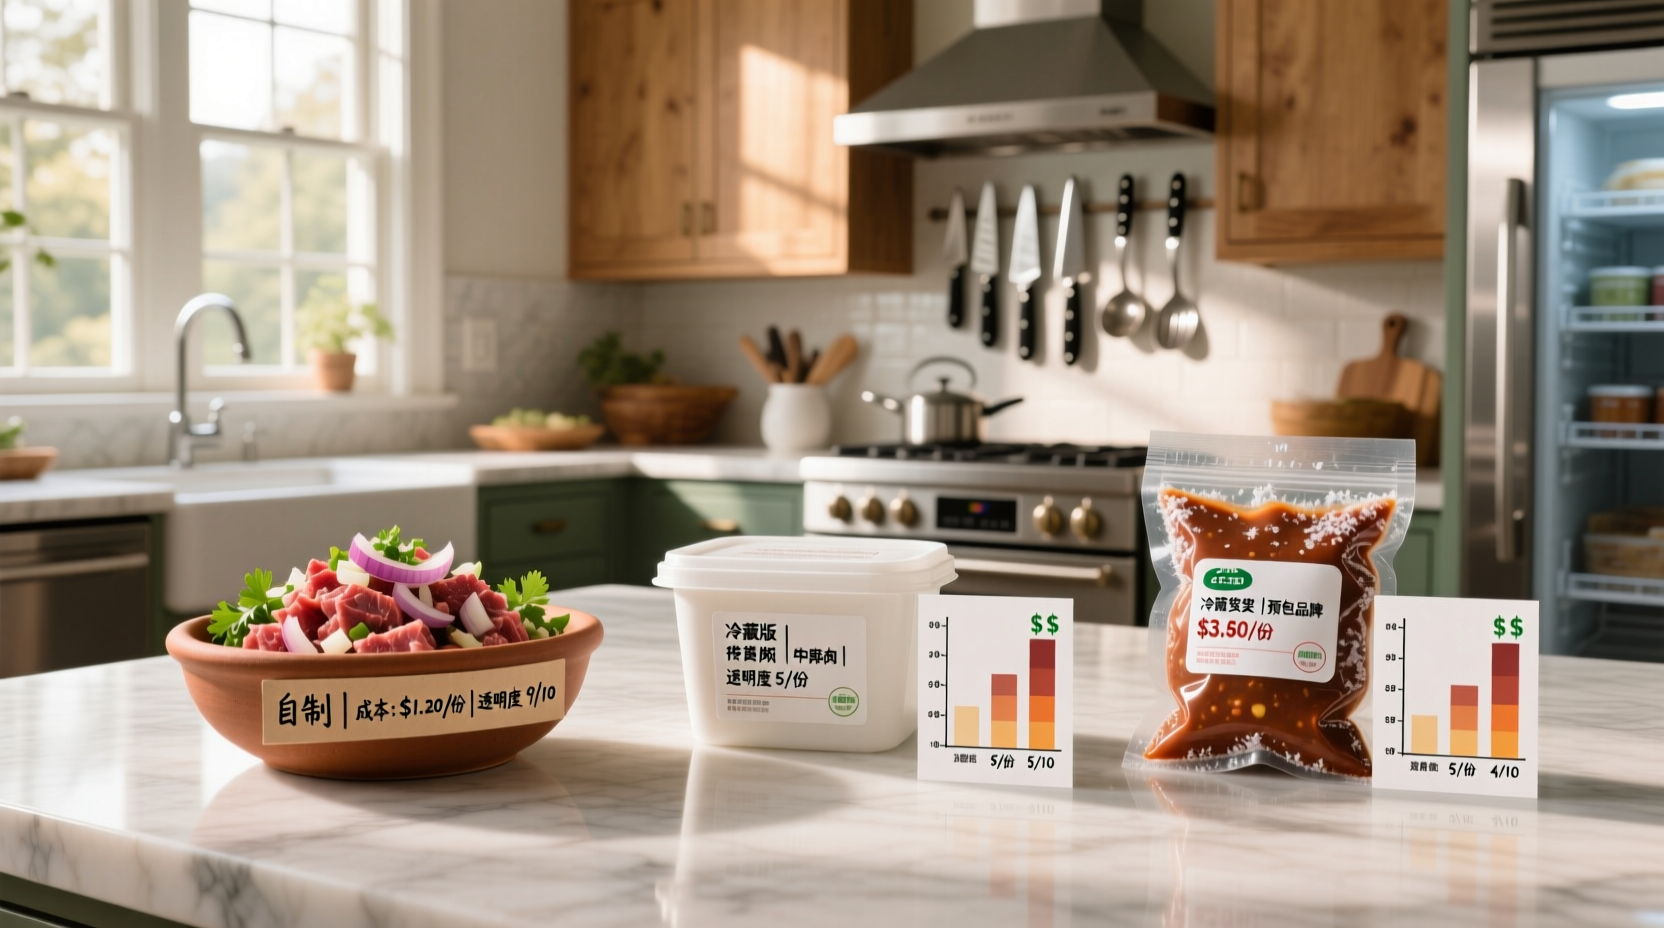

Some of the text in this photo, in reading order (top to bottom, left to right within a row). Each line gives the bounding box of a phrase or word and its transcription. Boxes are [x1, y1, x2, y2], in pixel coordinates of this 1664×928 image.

[1197, 617, 1274, 641] $3.50/份
[775, 670, 809, 689] 5/份
[278, 692, 332, 728] 自制
[526, 681, 556, 708] 9/10
[1027, 755, 1055, 771] 5/10
[1490, 764, 1520, 779] 4/10
